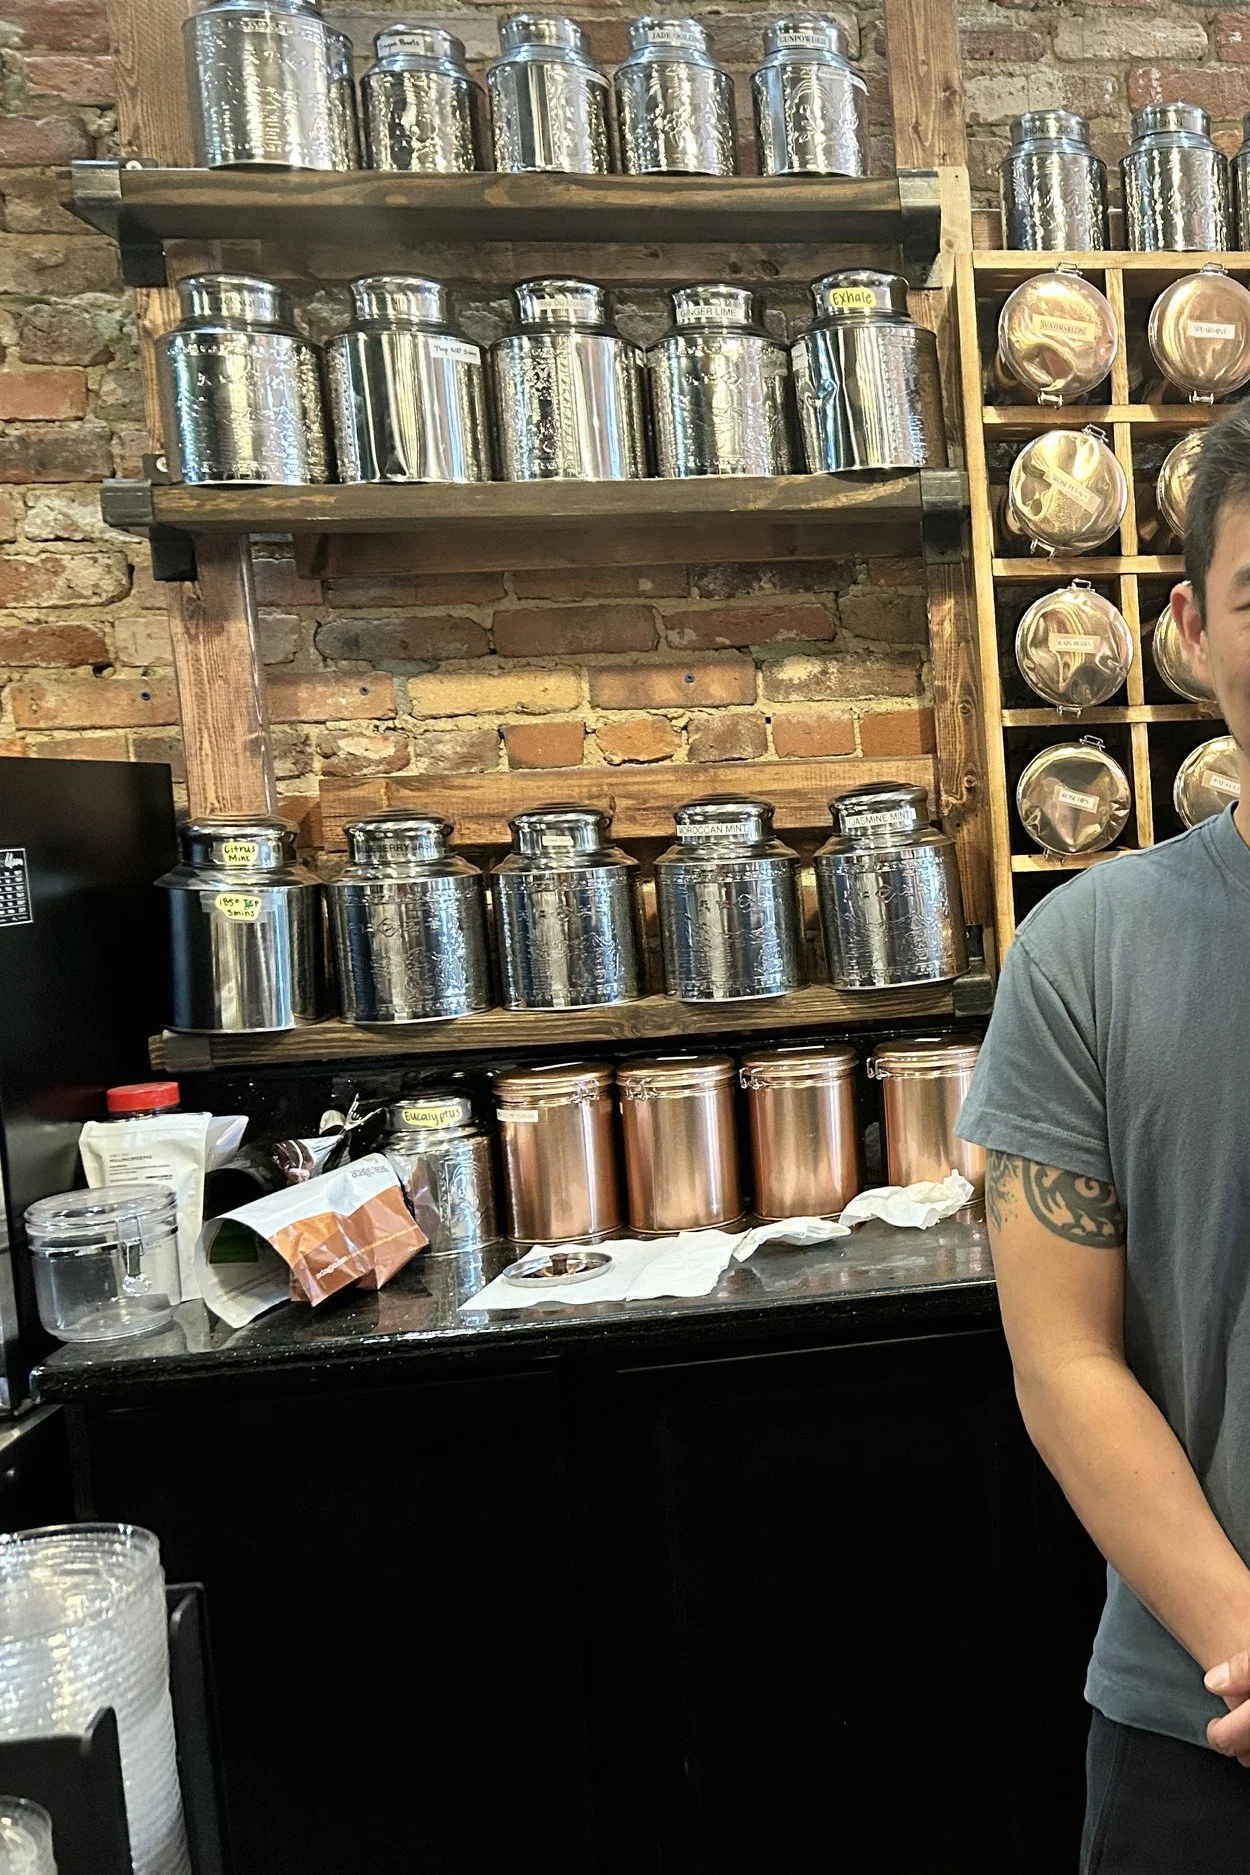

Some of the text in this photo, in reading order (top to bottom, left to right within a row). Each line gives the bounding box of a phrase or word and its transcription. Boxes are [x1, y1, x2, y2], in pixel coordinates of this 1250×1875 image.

[652, 31, 670, 41] JADE
[779, 36, 827, 46] GUNPOWDER
[1024, 127, 1044, 138] IRON
[832, 290, 873, 306] Exhale
[680, 307, 736, 318] GINGER LIME
[852, 811, 910, 826] JASMINE MINT
[679, 823, 748, 836] MOROCCAN MINT
[224, 845, 256, 854] Citrus
[357, 842, 410, 855] LUEBERRY
[228, 854, 251, 862] Mint
[404, 1108, 461, 1126] Eucalyptus
